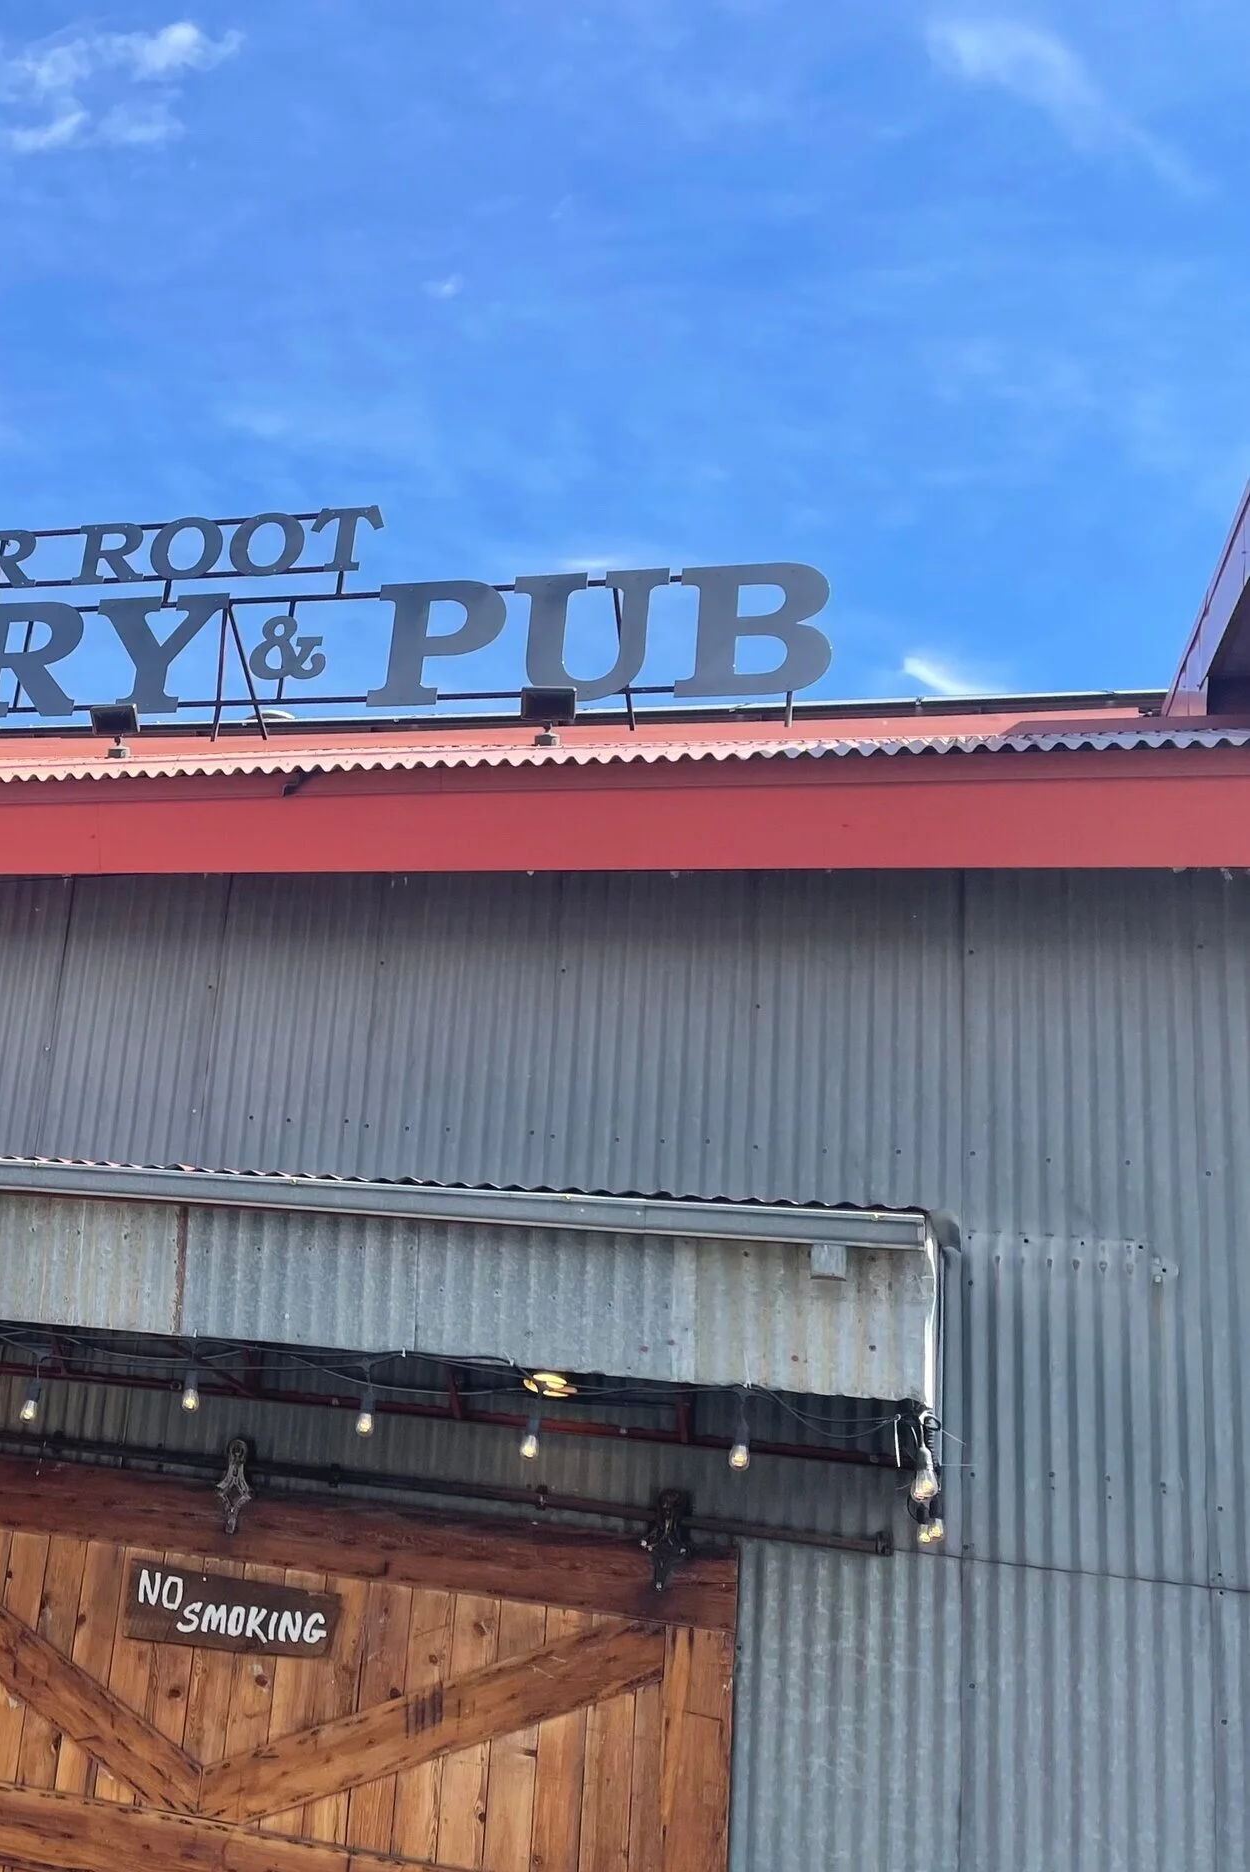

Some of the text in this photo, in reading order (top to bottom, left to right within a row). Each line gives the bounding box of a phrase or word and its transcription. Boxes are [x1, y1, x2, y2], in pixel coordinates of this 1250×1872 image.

[71, 504, 384, 585] ROOT
[249, 614, 326, 680] &
[366, 562, 833, 707] PUB
[138, 1569, 327, 1644] NO SMOKING
